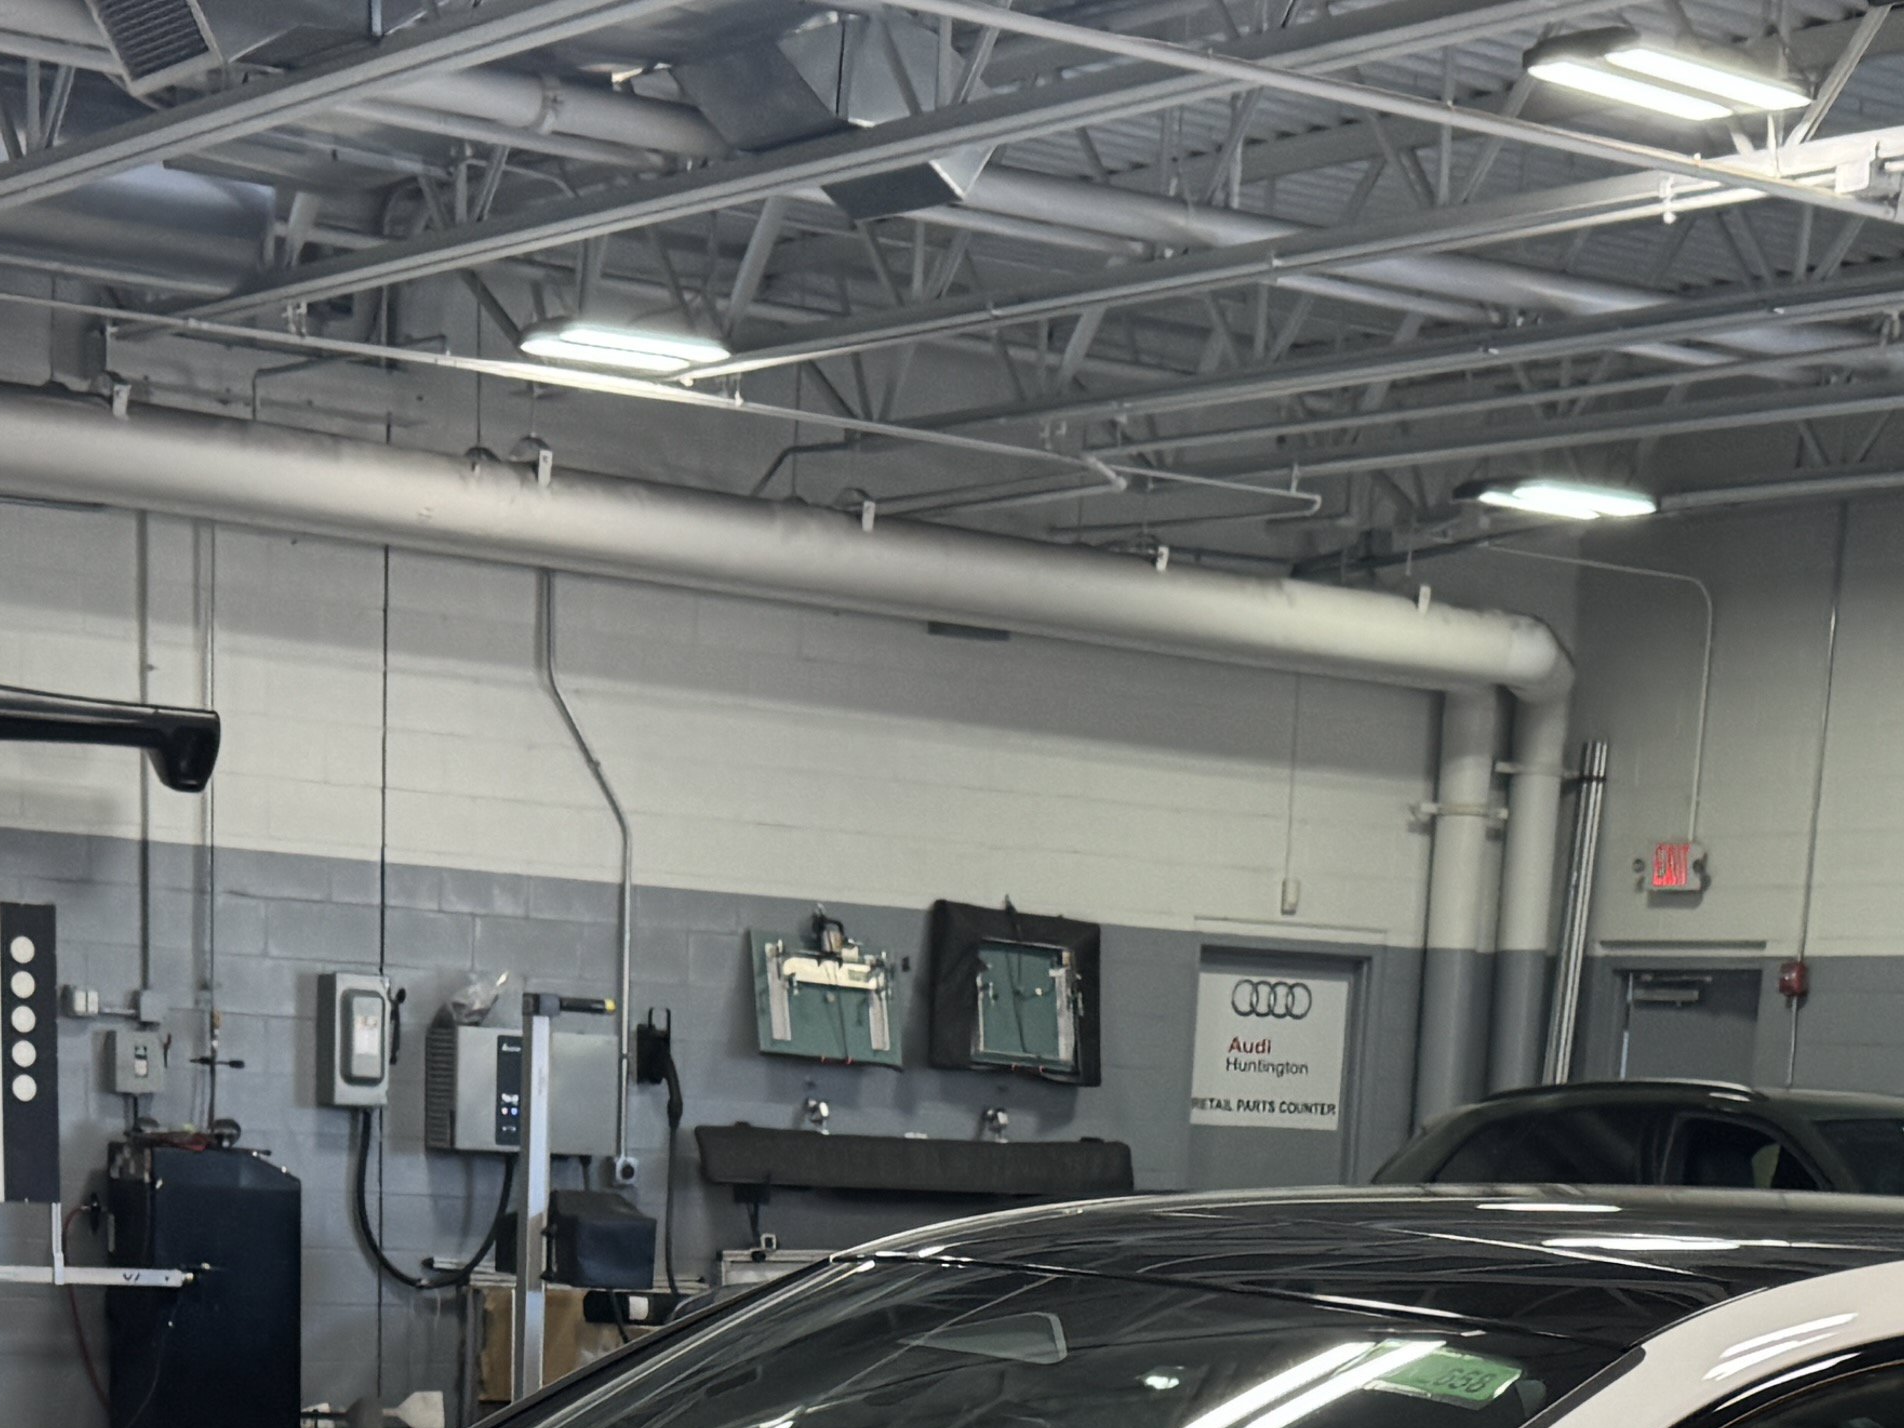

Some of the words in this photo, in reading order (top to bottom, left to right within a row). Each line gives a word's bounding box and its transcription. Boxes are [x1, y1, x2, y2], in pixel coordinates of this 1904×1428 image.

[1228, 1036, 1272, 1054] Audi
[1226, 1057, 1309, 1078] Huntington
[1236, 1098, 1275, 1114] PARTS
[1279, 1100, 1337, 1116] COUNTER
